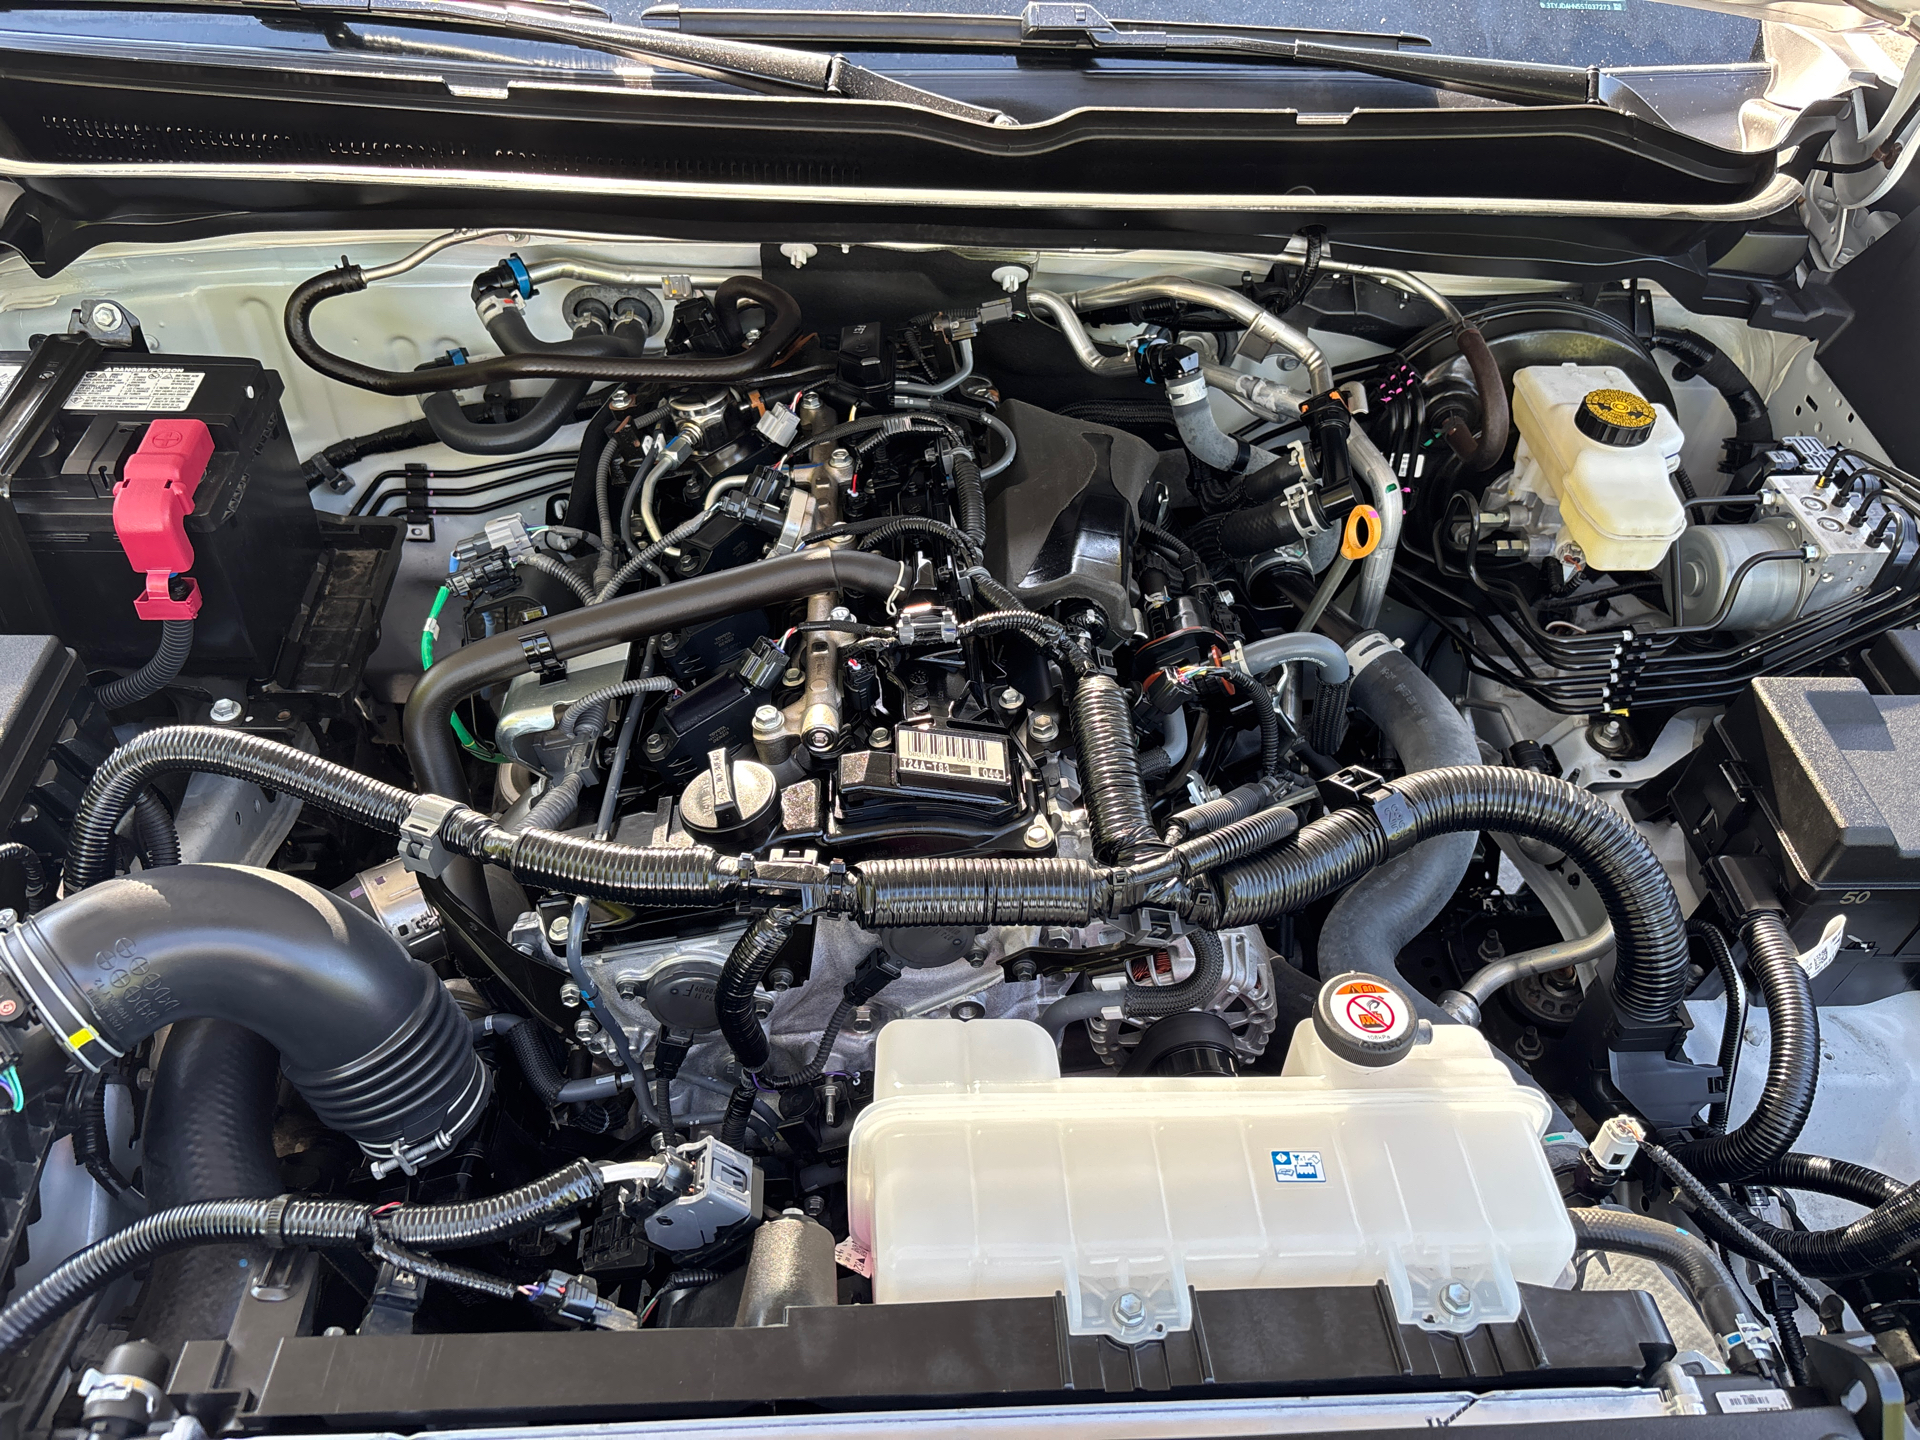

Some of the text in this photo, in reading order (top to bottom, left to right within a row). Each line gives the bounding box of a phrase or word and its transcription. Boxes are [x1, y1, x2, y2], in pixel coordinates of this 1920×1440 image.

[901, 758, 950, 774] T24A-T83
[982, 768, 1002, 780] 044
[1839, 890, 1871, 905] 50
[1358, 1037, 1403, 1052] DENSO
